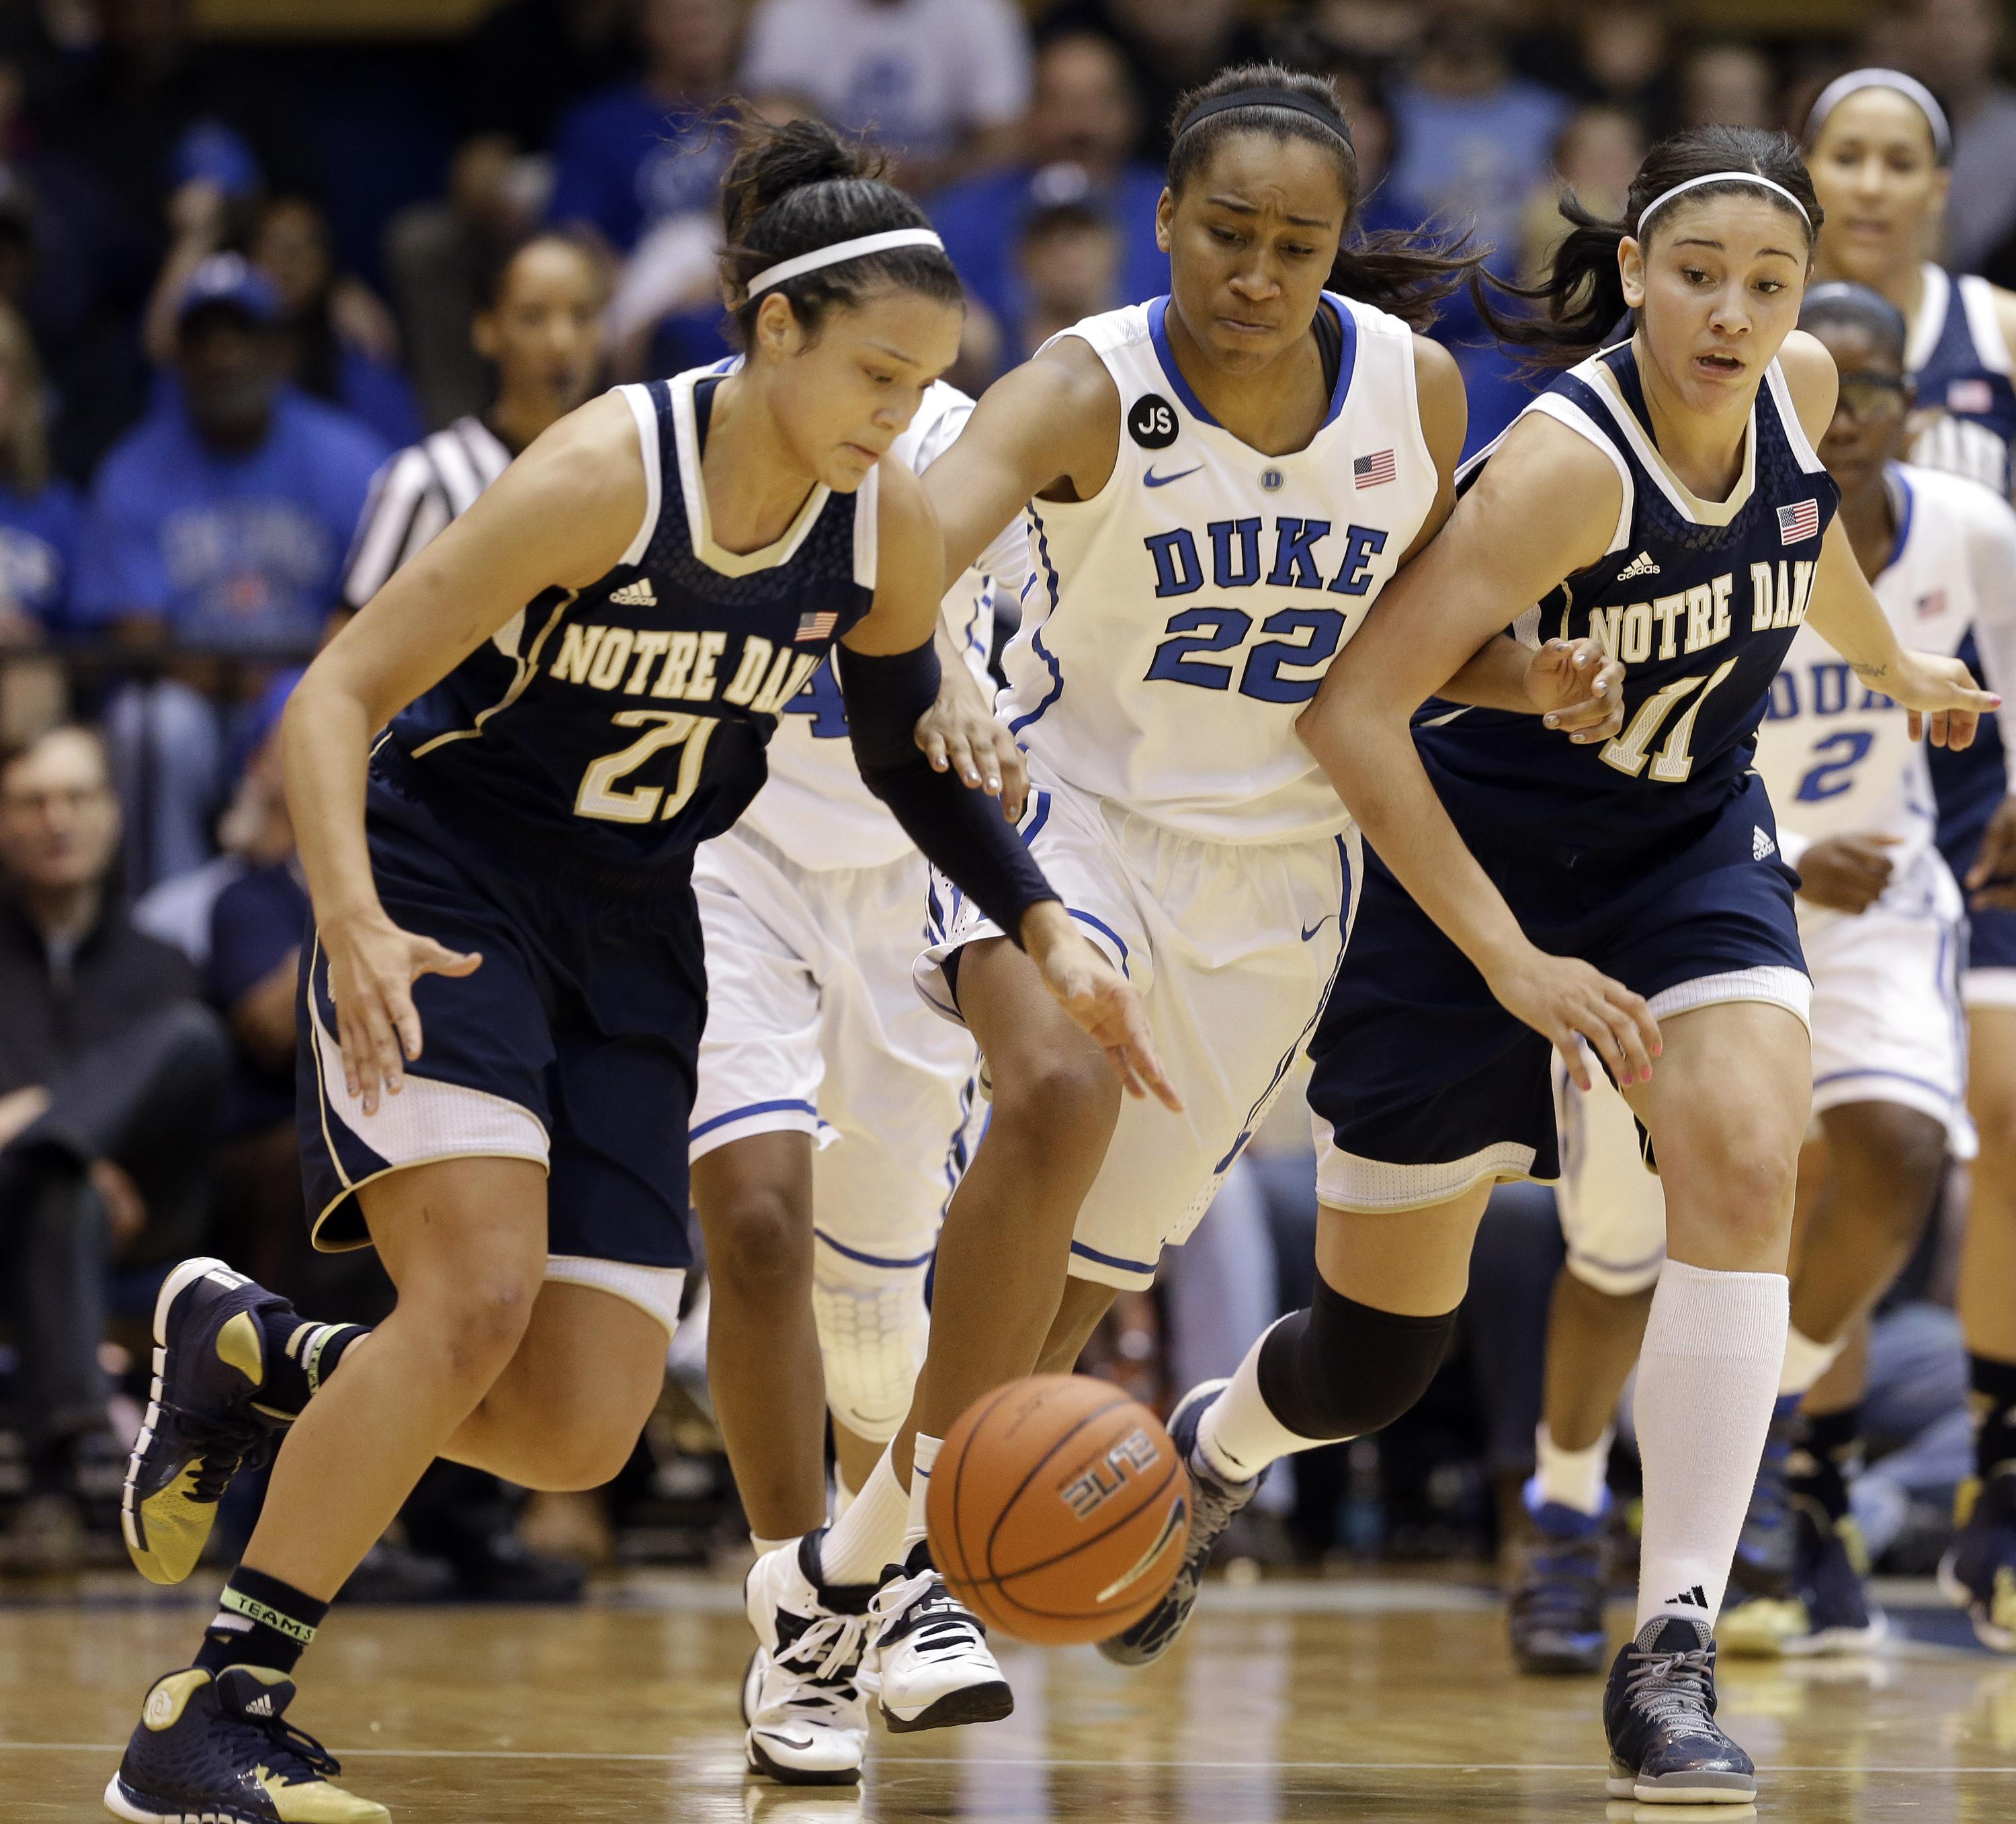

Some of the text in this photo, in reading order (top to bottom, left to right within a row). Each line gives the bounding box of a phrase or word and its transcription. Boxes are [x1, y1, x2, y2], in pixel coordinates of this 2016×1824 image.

[1138, 407, 1173, 435] JS
[1144, 516, 1389, 597] DUKE
[1617, 565, 1661, 582] adidas
[1143, 607, 1347, 703] 22
[1588, 560, 1818, 664] NOTRE DAM
[549, 623, 821, 713] NOTRE DAM
[1598, 655, 1739, 783] 11
[573, 709, 722, 824] 21
[1794, 730, 1875, 804] 2
